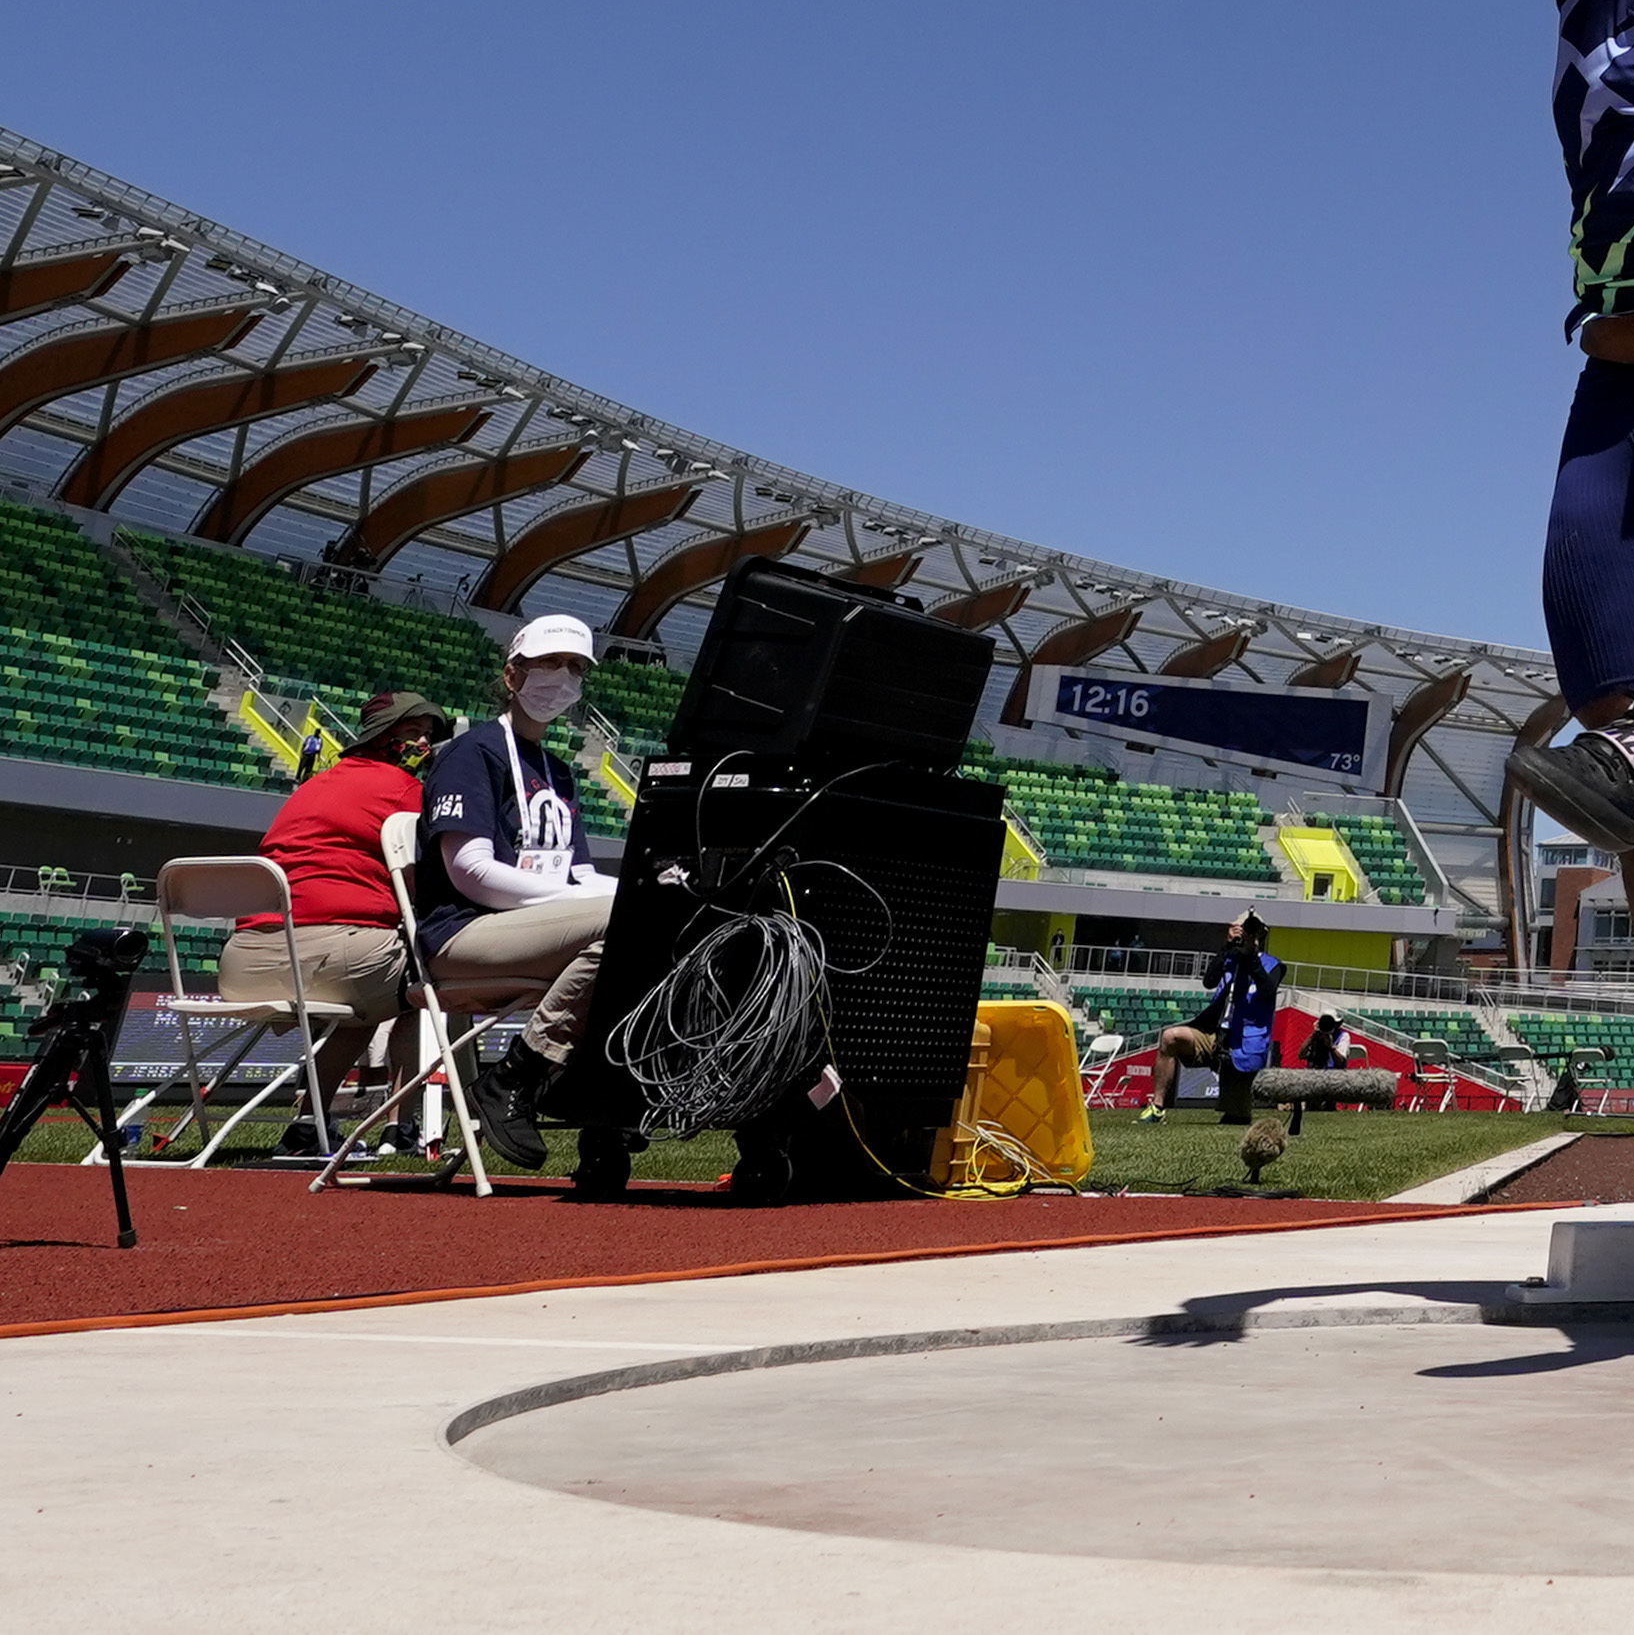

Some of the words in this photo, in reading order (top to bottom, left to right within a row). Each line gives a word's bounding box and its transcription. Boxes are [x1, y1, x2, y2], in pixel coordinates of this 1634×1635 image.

[1071, 684, 1150, 717] 12:16
[1329, 753, 1361, 770] 73°
[432, 800, 464, 821] USA
